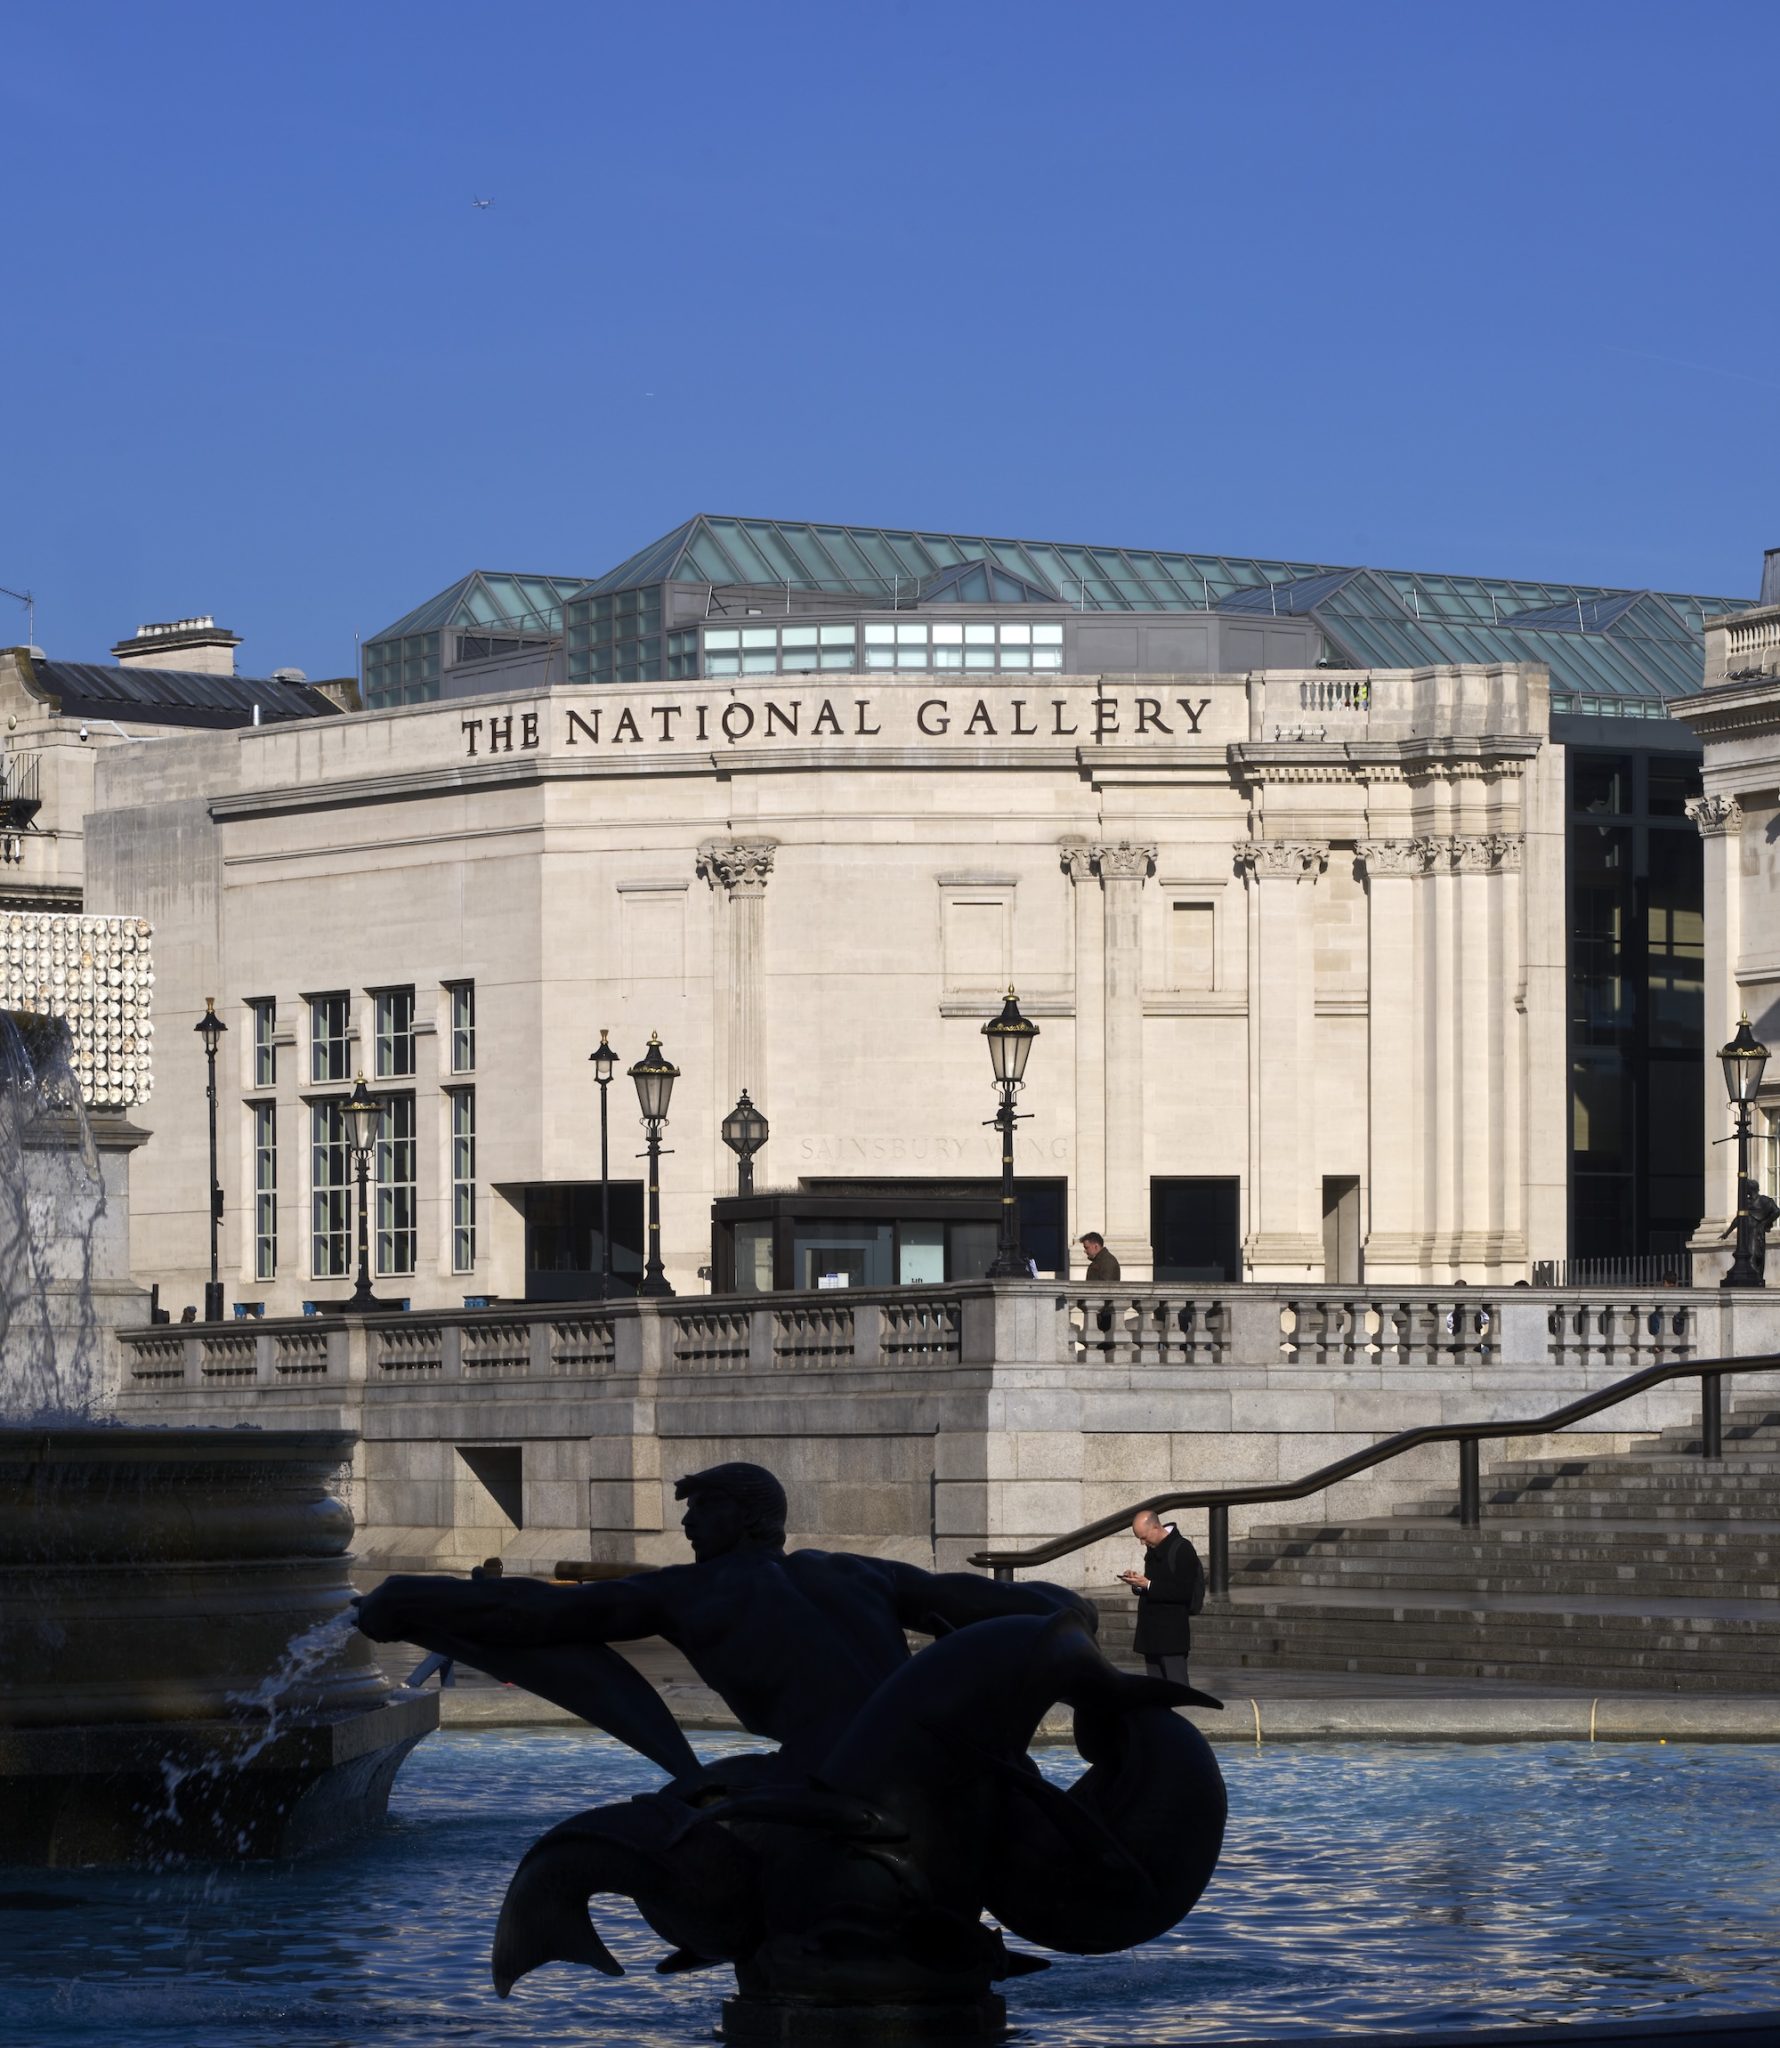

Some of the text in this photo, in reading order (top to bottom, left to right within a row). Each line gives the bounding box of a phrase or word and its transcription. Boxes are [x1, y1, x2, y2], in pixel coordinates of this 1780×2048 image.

[462, 699, 1211, 757] THE NATIONAL GALLERY
[800, 1137, 968, 1160] SAINSBURY
